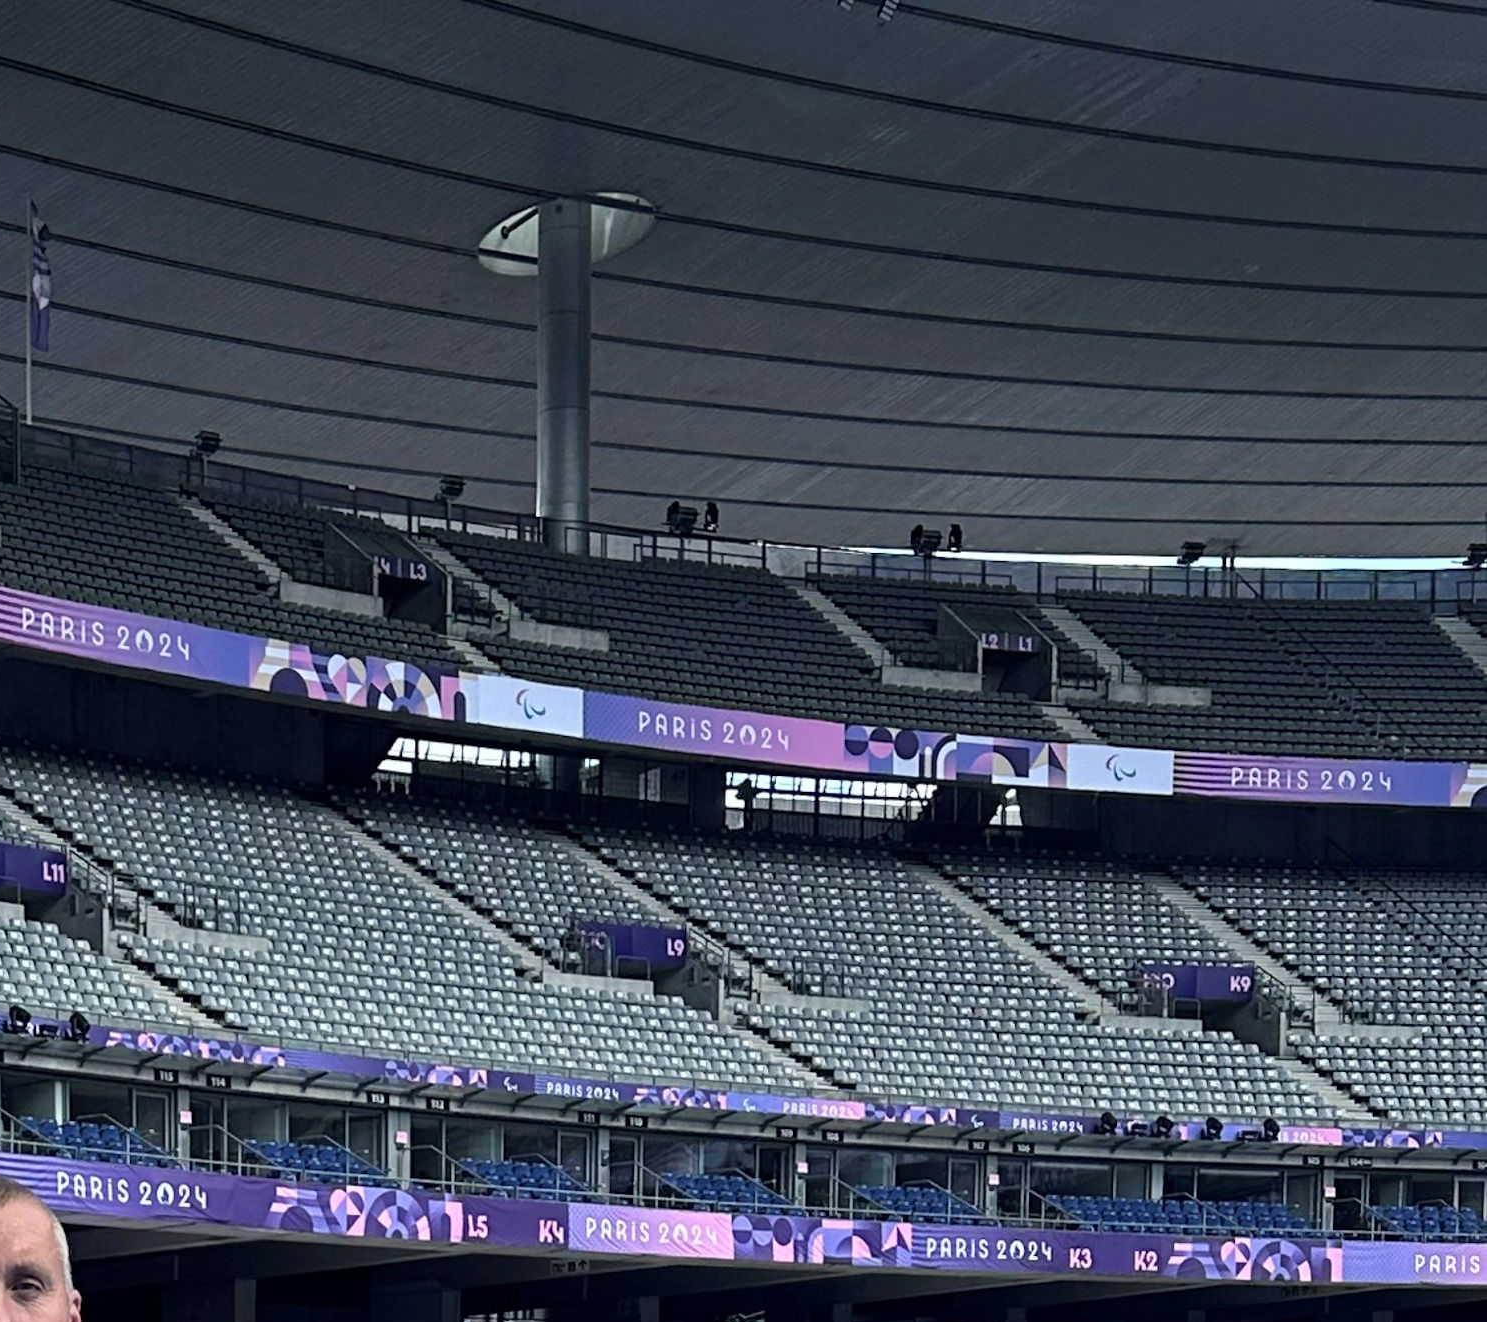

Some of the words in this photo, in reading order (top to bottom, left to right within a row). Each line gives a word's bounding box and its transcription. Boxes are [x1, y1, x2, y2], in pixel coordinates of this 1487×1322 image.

[409, 562, 428, 581] L3
[117, 625, 191, 661] 2024
[981, 632, 999, 650] L2
[1018, 635, 1033, 652] L1
[722, 721, 790, 751] 2024
[1321, 769, 1392, 792] 2024
[42, 860, 65, 884] L11
[666, 937, 685, 957] L9
[1229, 975, 1252, 993] K9
[586, 1085, 619, 1101] 2024
[139, 1181, 208, 1209] 2024
[467, 1213, 489, 1239] L5
[539, 1219, 564, 1244] K4
[658, 1223, 717, 1246] 2024
[997, 1240, 1052, 1262] 2024
[1069, 1247, 1093, 1269] K3
[1133, 1250, 1159, 1272] K2
